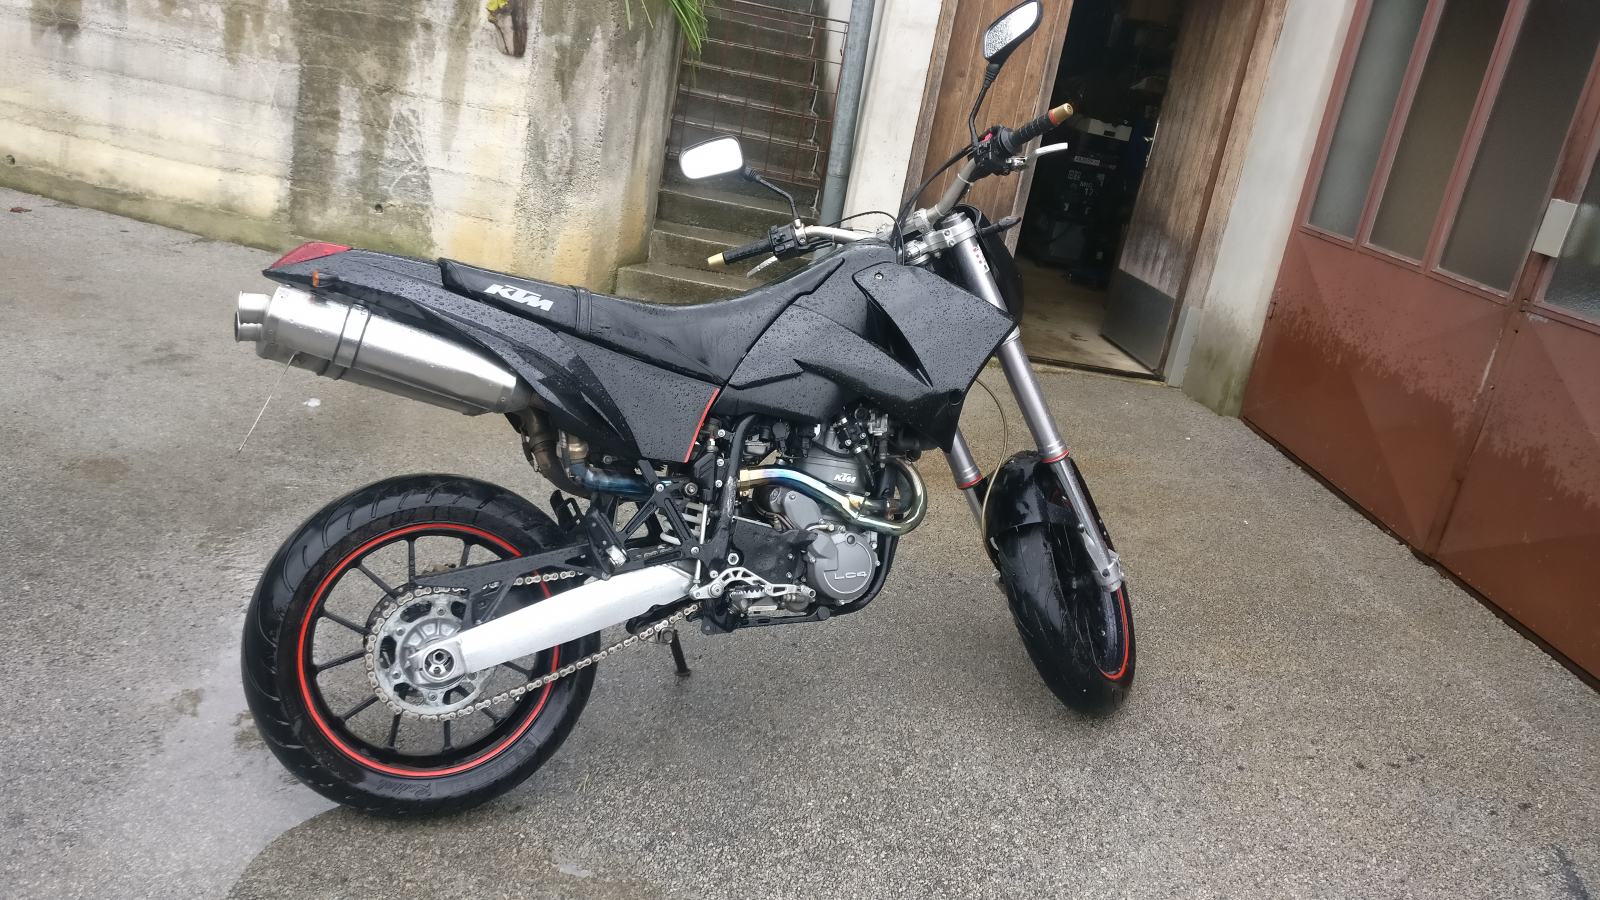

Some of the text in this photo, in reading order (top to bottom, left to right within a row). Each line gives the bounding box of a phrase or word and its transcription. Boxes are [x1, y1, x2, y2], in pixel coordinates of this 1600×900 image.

[483, 283, 554, 311] KTM
[833, 472, 857, 484] KTM
[834, 571, 868, 581] LC4
